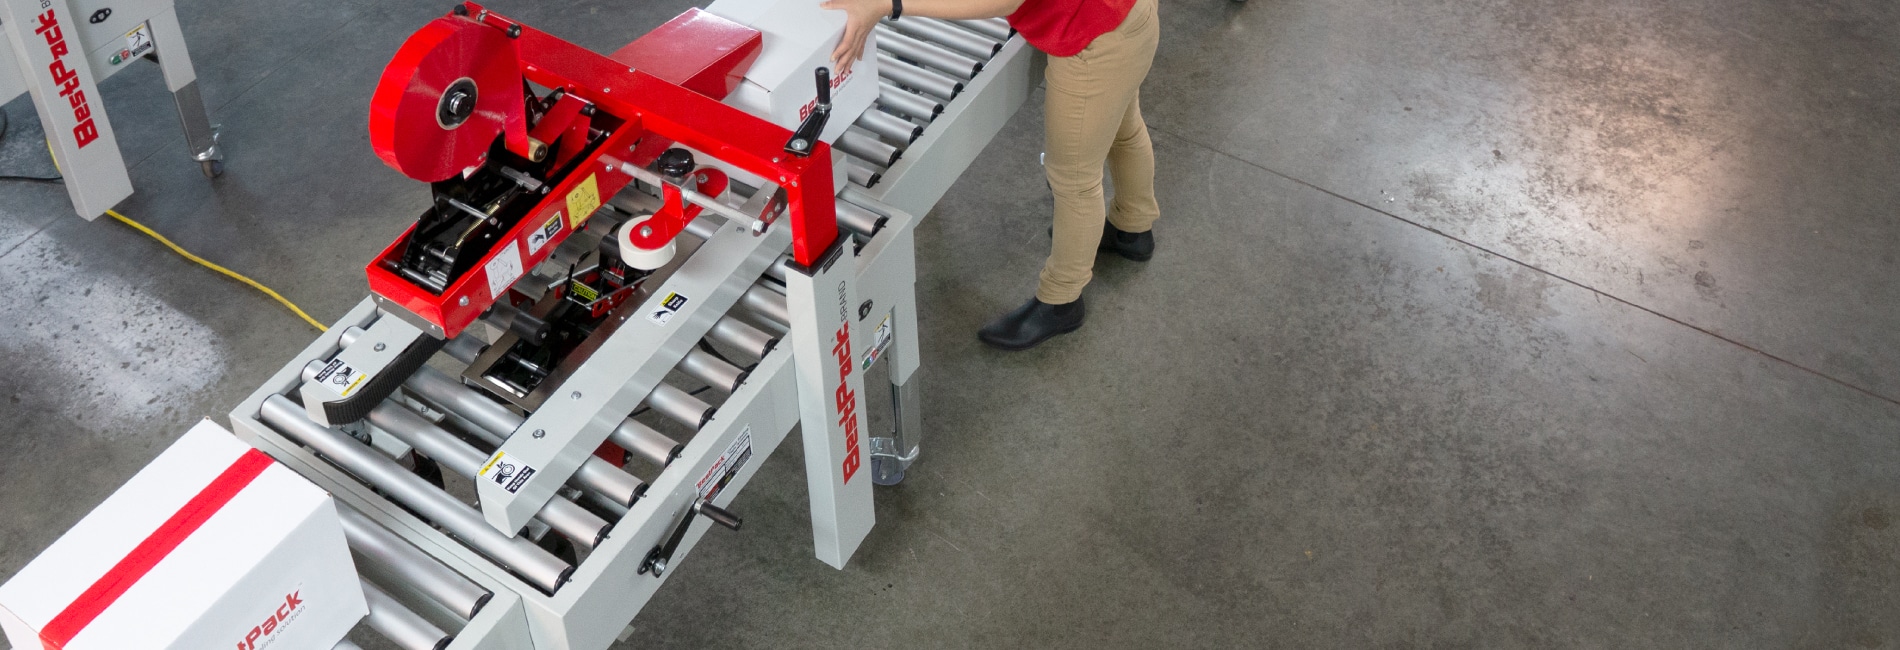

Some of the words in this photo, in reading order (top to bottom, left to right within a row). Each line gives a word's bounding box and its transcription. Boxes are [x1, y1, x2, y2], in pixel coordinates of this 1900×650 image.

[35, 9, 99, 150] BestPack
[838, 280, 848, 322] BRAND
[832, 320, 860, 485] BestPack
[276, 605, 306, 637] solution
